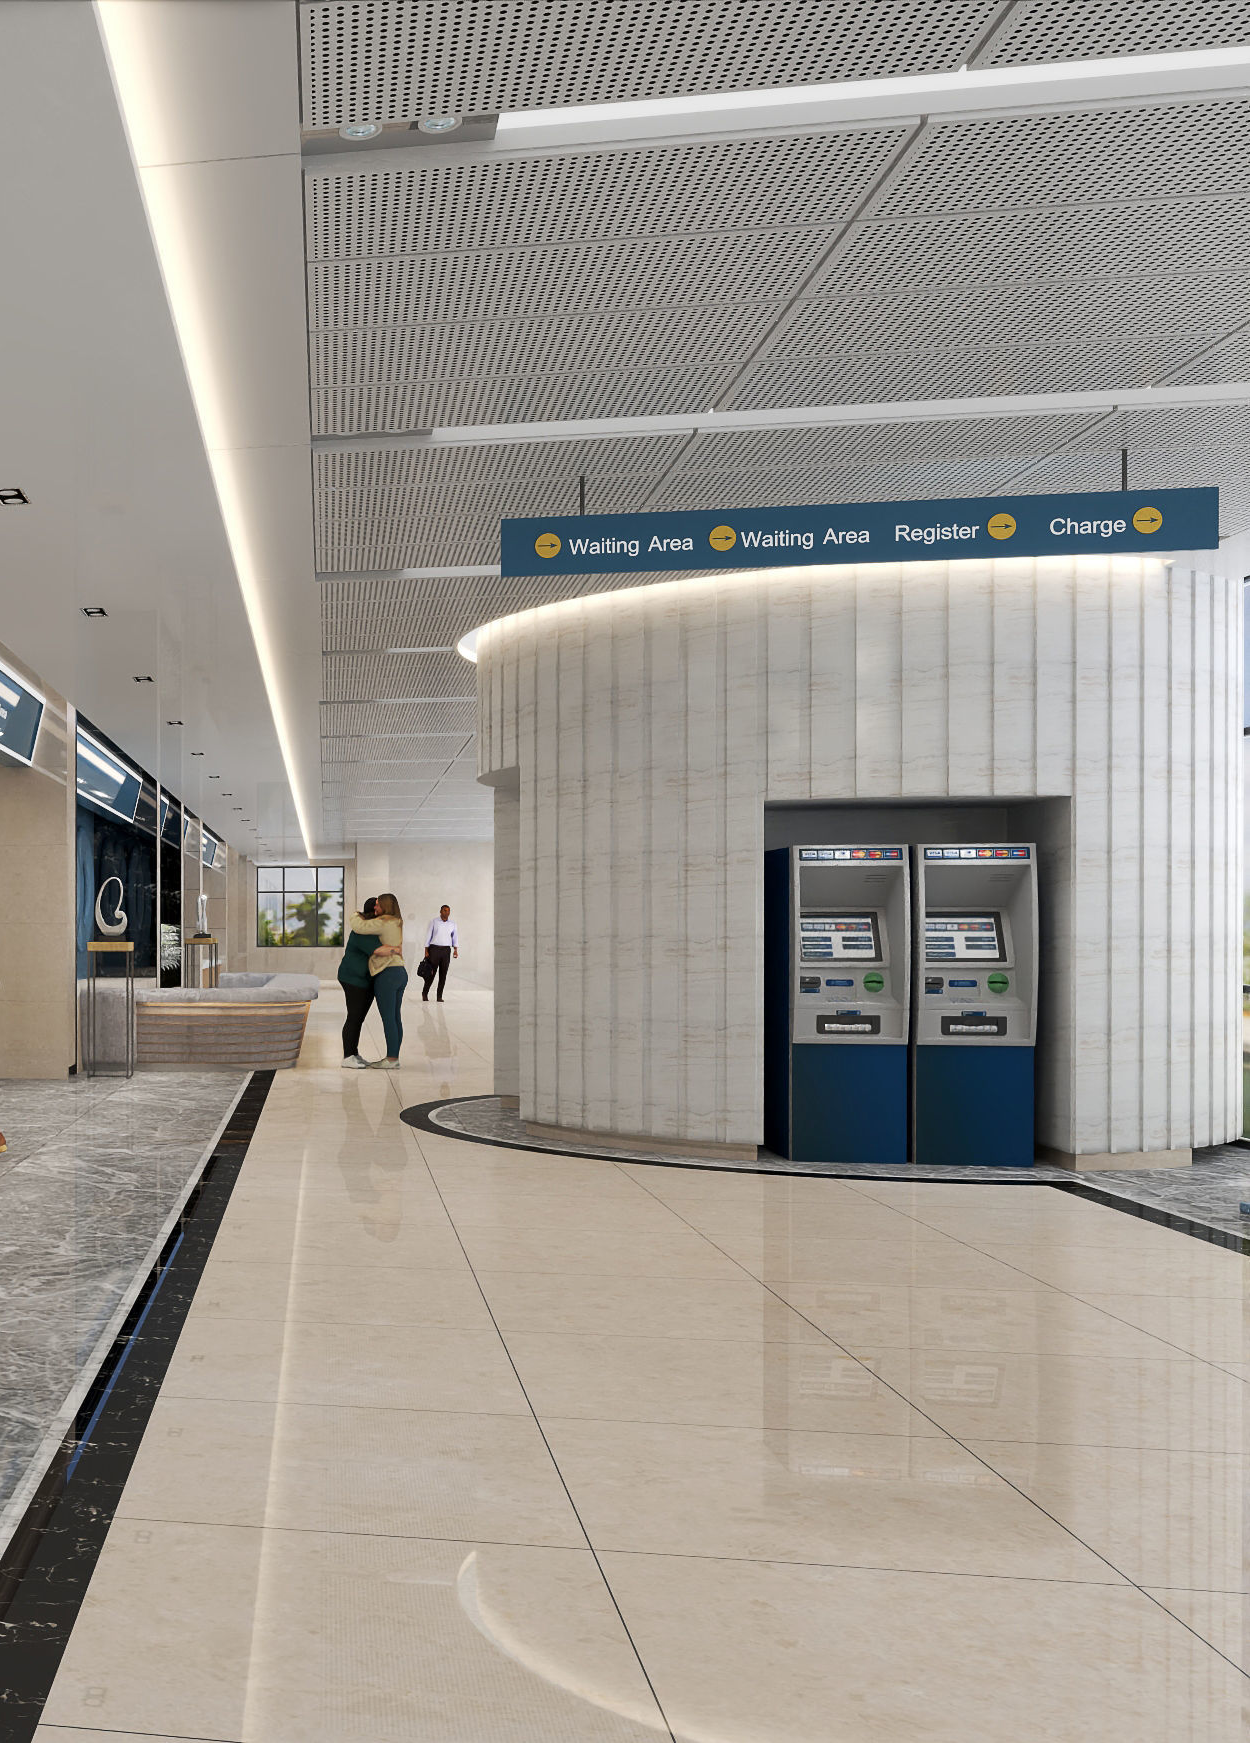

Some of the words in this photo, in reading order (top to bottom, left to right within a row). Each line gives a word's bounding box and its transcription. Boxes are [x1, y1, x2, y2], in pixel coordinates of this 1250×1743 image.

[740, 530, 814, 550] Waiting
[822, 527, 870, 545] Area
[895, 523, 980, 545] Register
[1049, 517, 1127, 538] Charge
[568, 538, 640, 557] Waiting
[647, 535, 694, 552] Area
